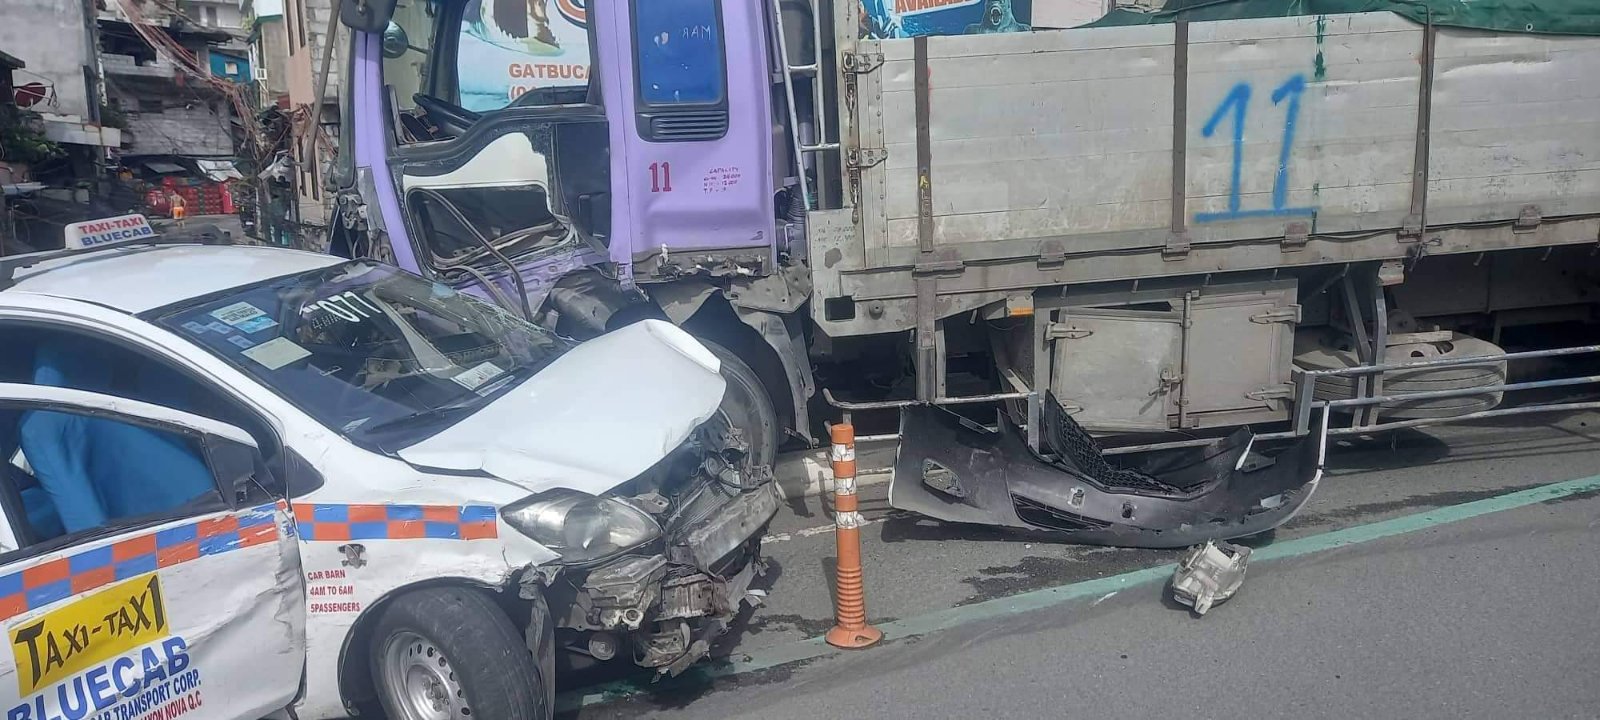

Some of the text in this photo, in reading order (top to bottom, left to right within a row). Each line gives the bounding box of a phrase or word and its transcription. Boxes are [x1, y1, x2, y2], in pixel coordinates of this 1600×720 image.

[1201, 74, 1307, 213] 11
[648, 162, 672, 192] 11
[79, 217, 144, 234] TAXI-TAXI
[81, 226, 152, 246] BLUECAB
[308, 569, 346, 580] CAR BARN
[310, 585, 354, 596] 4AM TO 6AM
[310, 602, 360, 613] 5PASSENGERS
[113, 668, 202, 720] TRANSPORT CORP.
[164, 697, 188, 720] NOVA
